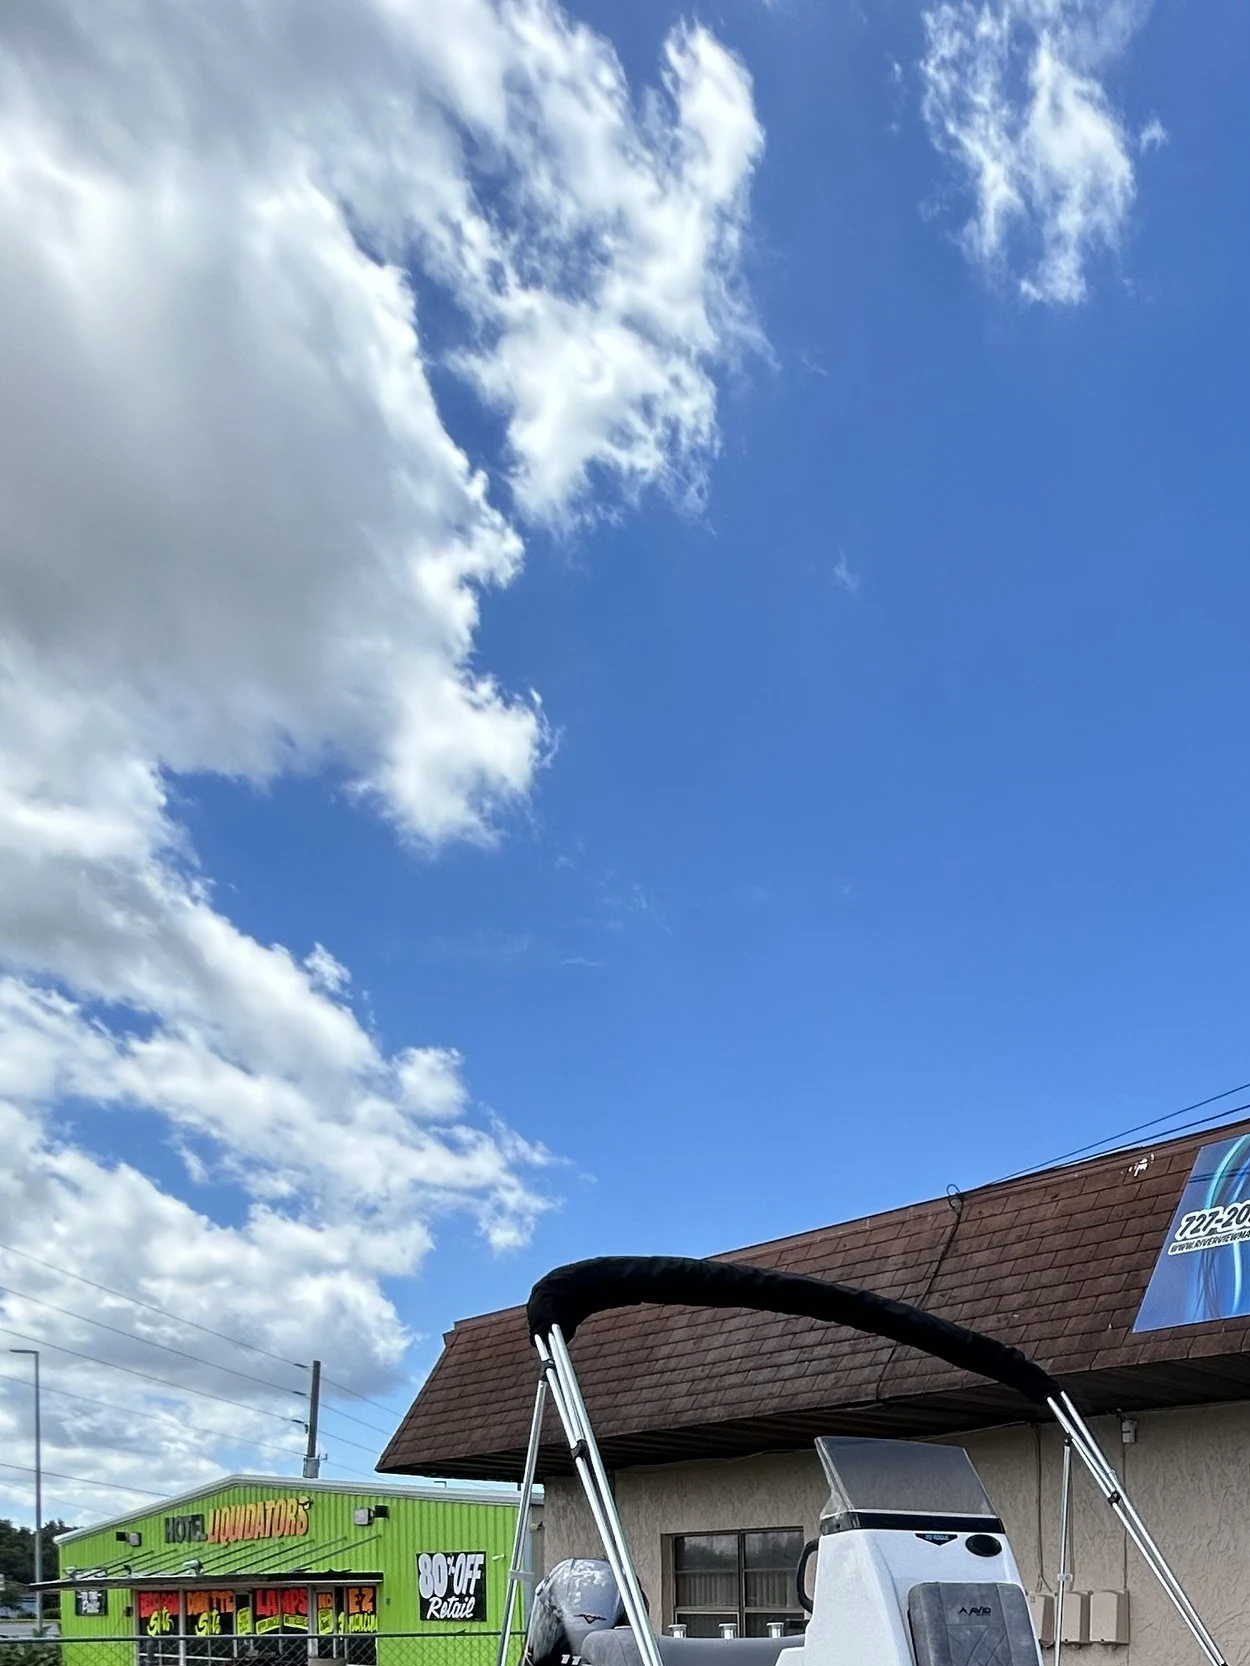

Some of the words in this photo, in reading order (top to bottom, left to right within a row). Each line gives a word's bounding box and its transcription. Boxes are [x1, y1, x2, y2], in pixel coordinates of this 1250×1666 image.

[164, 1514, 208, 1544] HOTEL
[207, 1498, 310, 1547] LIQUIDATORS
[418, 1552, 455, 1599] 80%
[453, 1552, 485, 1595] OFF
[426, 1596, 476, 1620] Retail
